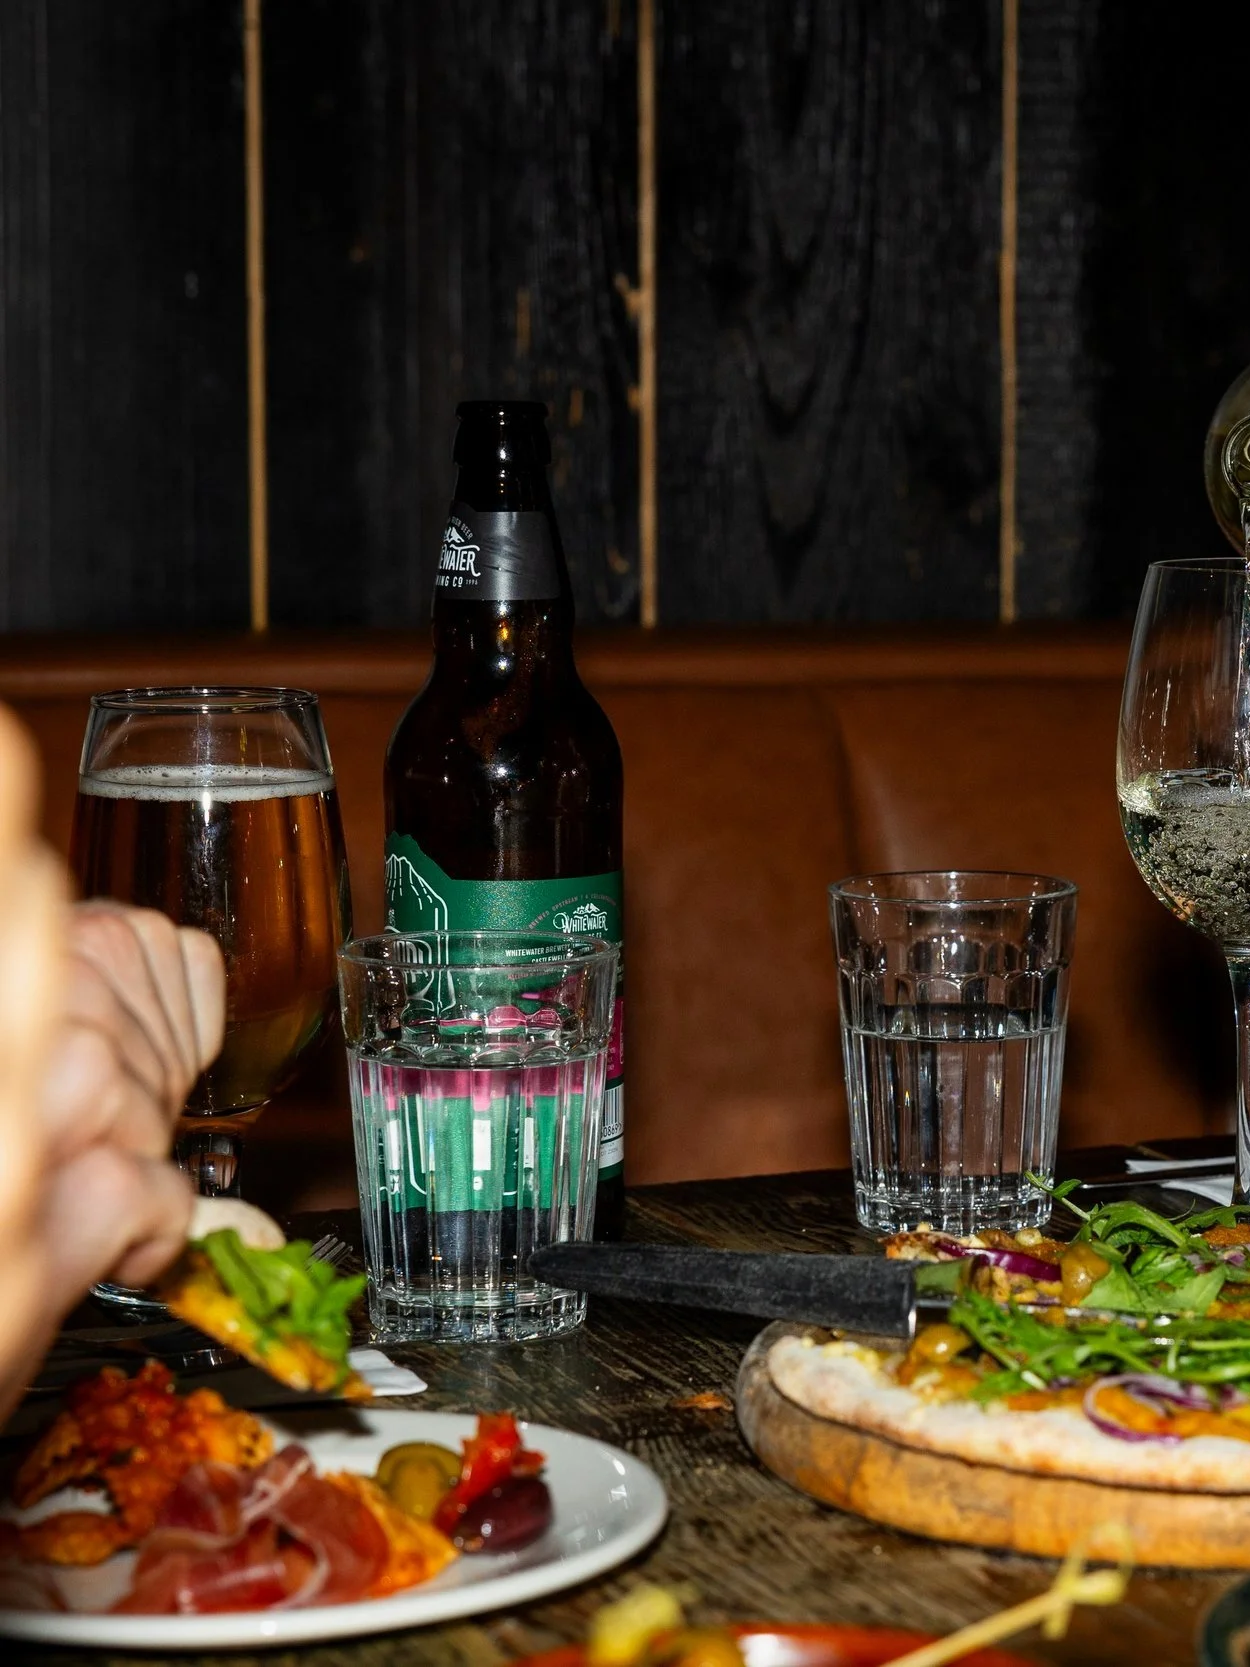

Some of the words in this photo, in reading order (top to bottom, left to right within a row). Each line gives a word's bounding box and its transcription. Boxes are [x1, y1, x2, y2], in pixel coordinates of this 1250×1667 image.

[460, 523, 473, 540] BEER
[553, 911, 608, 933] WHITEWATER
[505, 947, 544, 957] WHITEWATER
